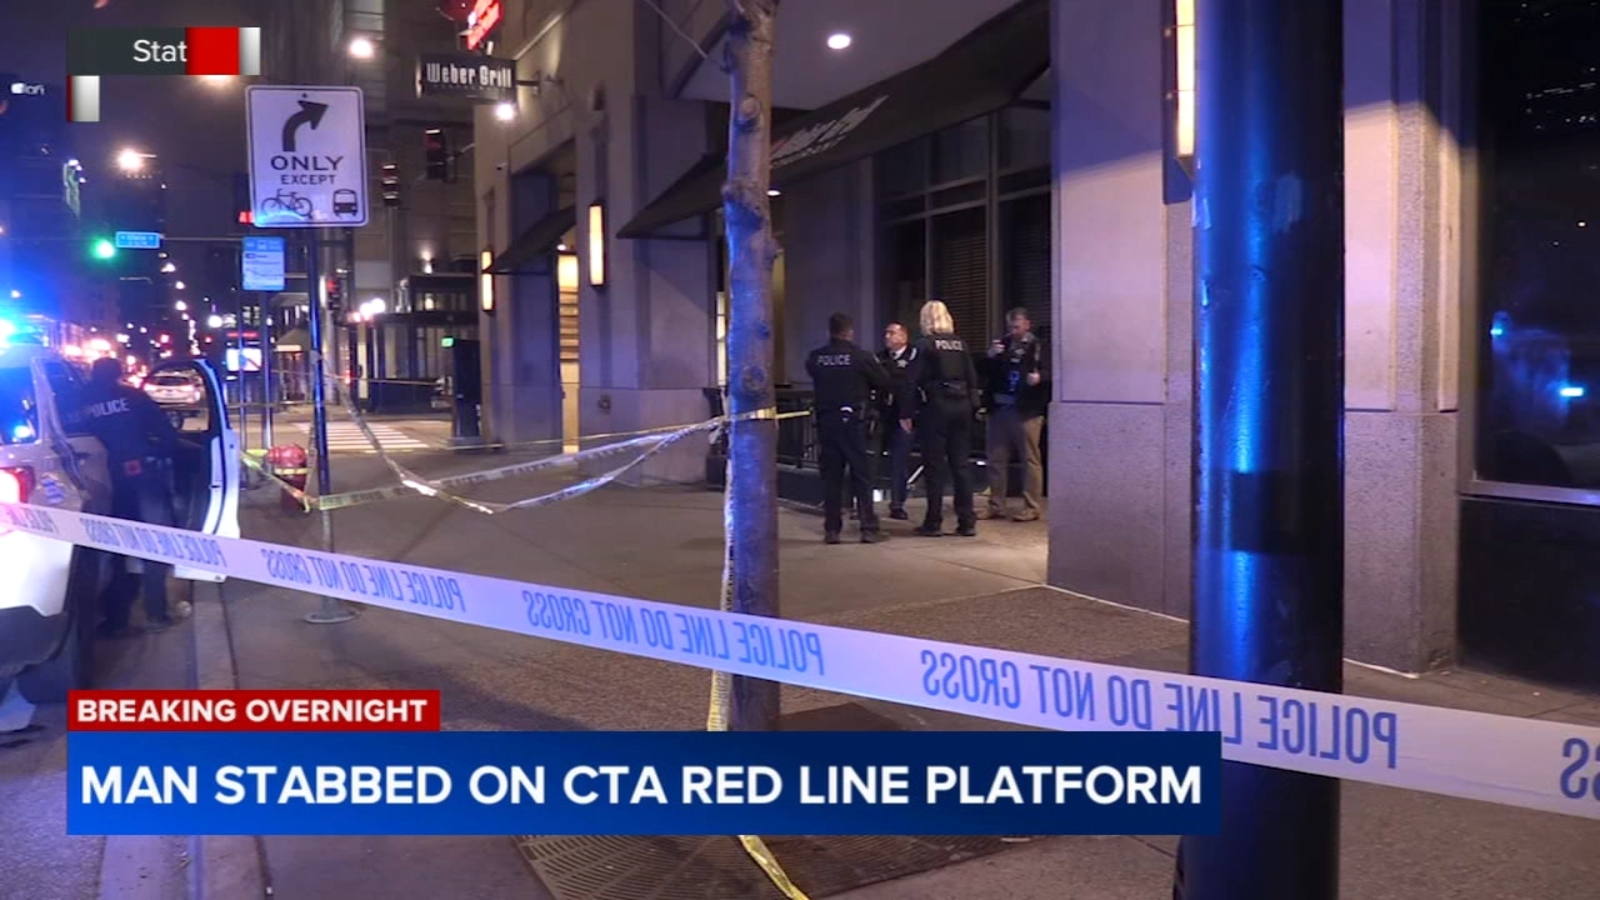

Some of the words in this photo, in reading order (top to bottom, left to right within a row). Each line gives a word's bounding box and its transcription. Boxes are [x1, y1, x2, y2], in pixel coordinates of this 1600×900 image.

[426, 63, 476, 84] Weber
[479, 65, 512, 88] Grill
[270, 155, 344, 170] ONLY
[280, 174, 336, 185] EXCEPT
[934, 339, 963, 351] POLICE
[818, 354, 851, 366] POLICE
